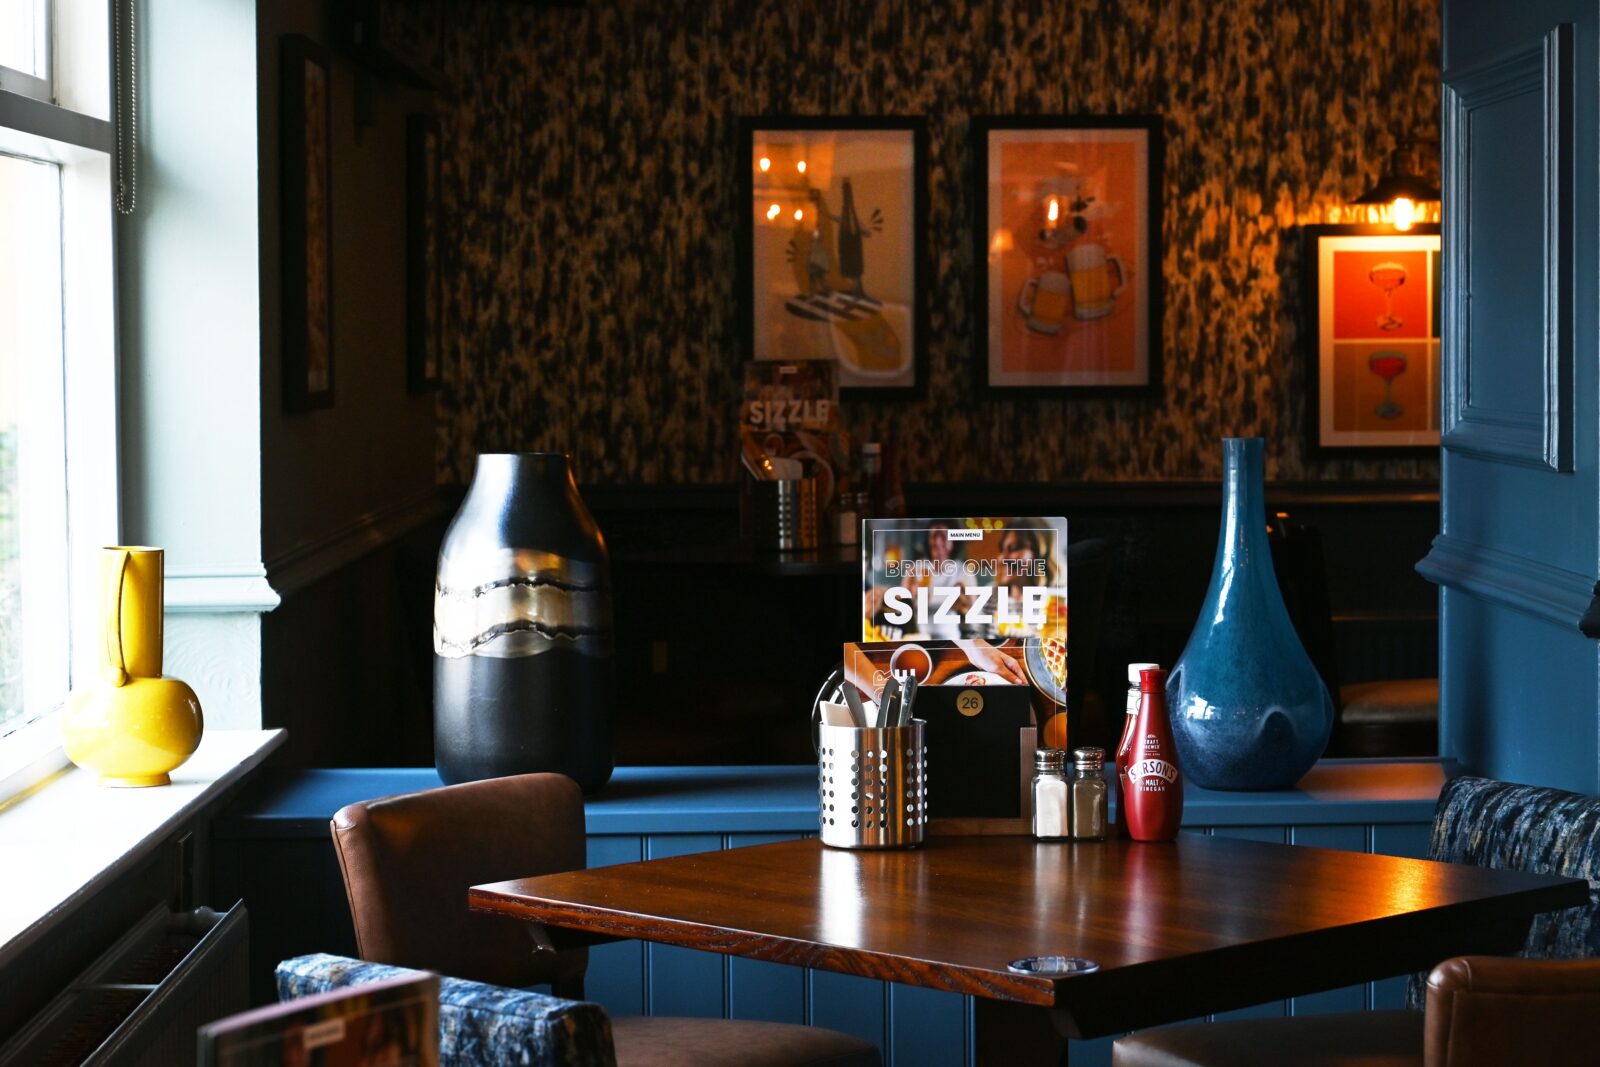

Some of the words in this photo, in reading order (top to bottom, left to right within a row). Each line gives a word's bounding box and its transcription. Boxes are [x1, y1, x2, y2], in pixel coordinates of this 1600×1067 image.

[750, 400, 828, 424] SIZZLE
[885, 559, 957, 578] BRING
[962, 559, 997, 577] ON
[1003, 559, 1046, 577] THE
[883, 586, 1047, 625] SIZZLE
[962, 697, 978, 709] 26
[1130, 760, 1175, 780] SRSON'S
